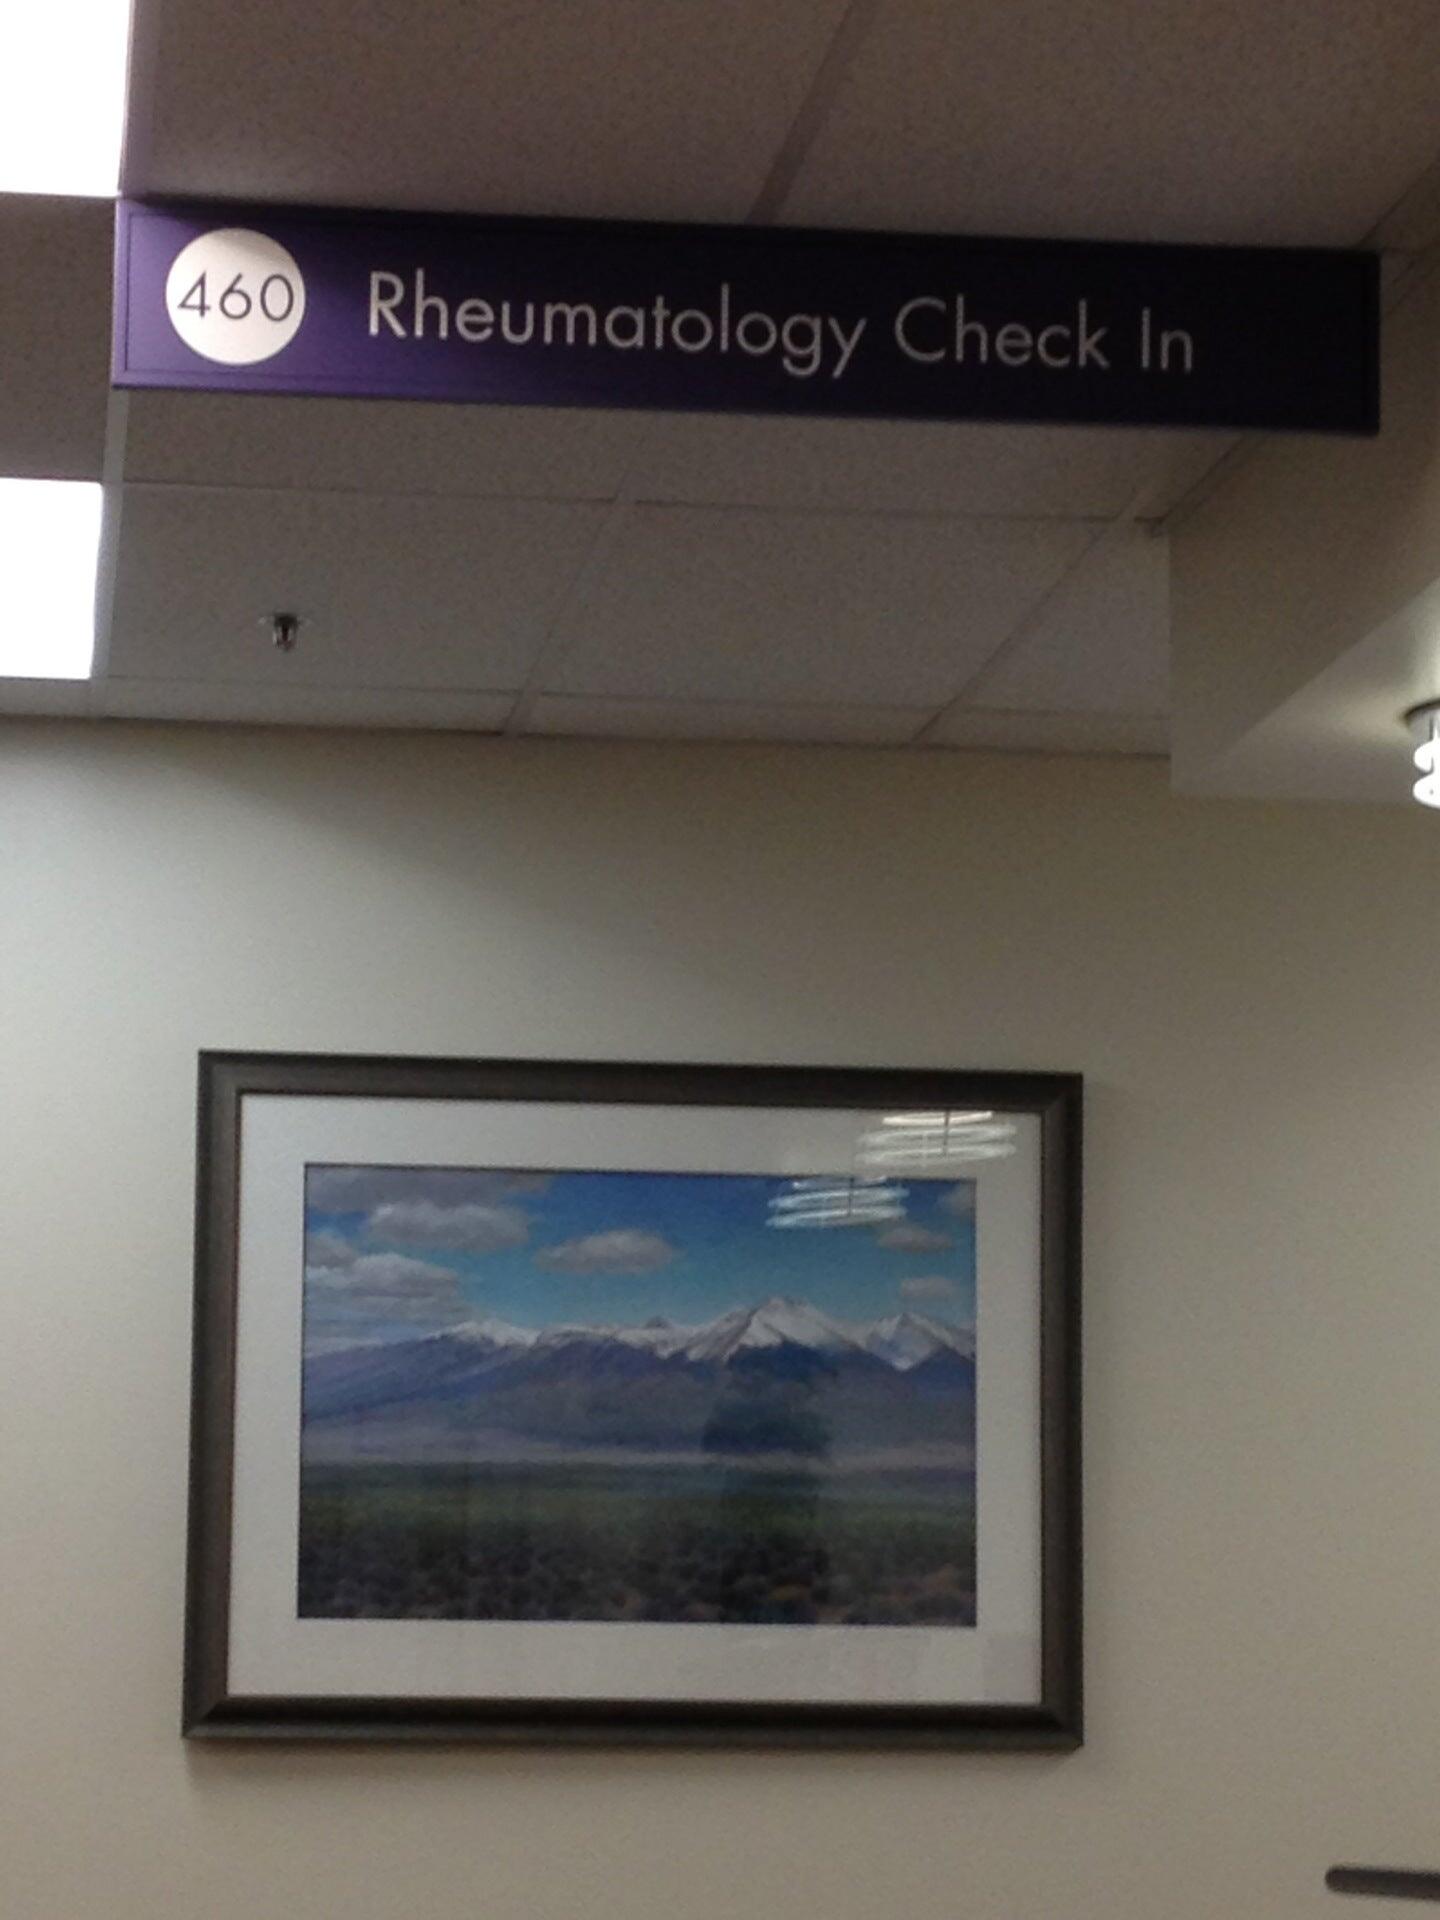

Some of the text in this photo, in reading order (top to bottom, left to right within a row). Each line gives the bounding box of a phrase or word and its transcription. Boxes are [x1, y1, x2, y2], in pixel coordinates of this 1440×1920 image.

[178, 267, 1194, 379] 460 Rheumatology Check In
